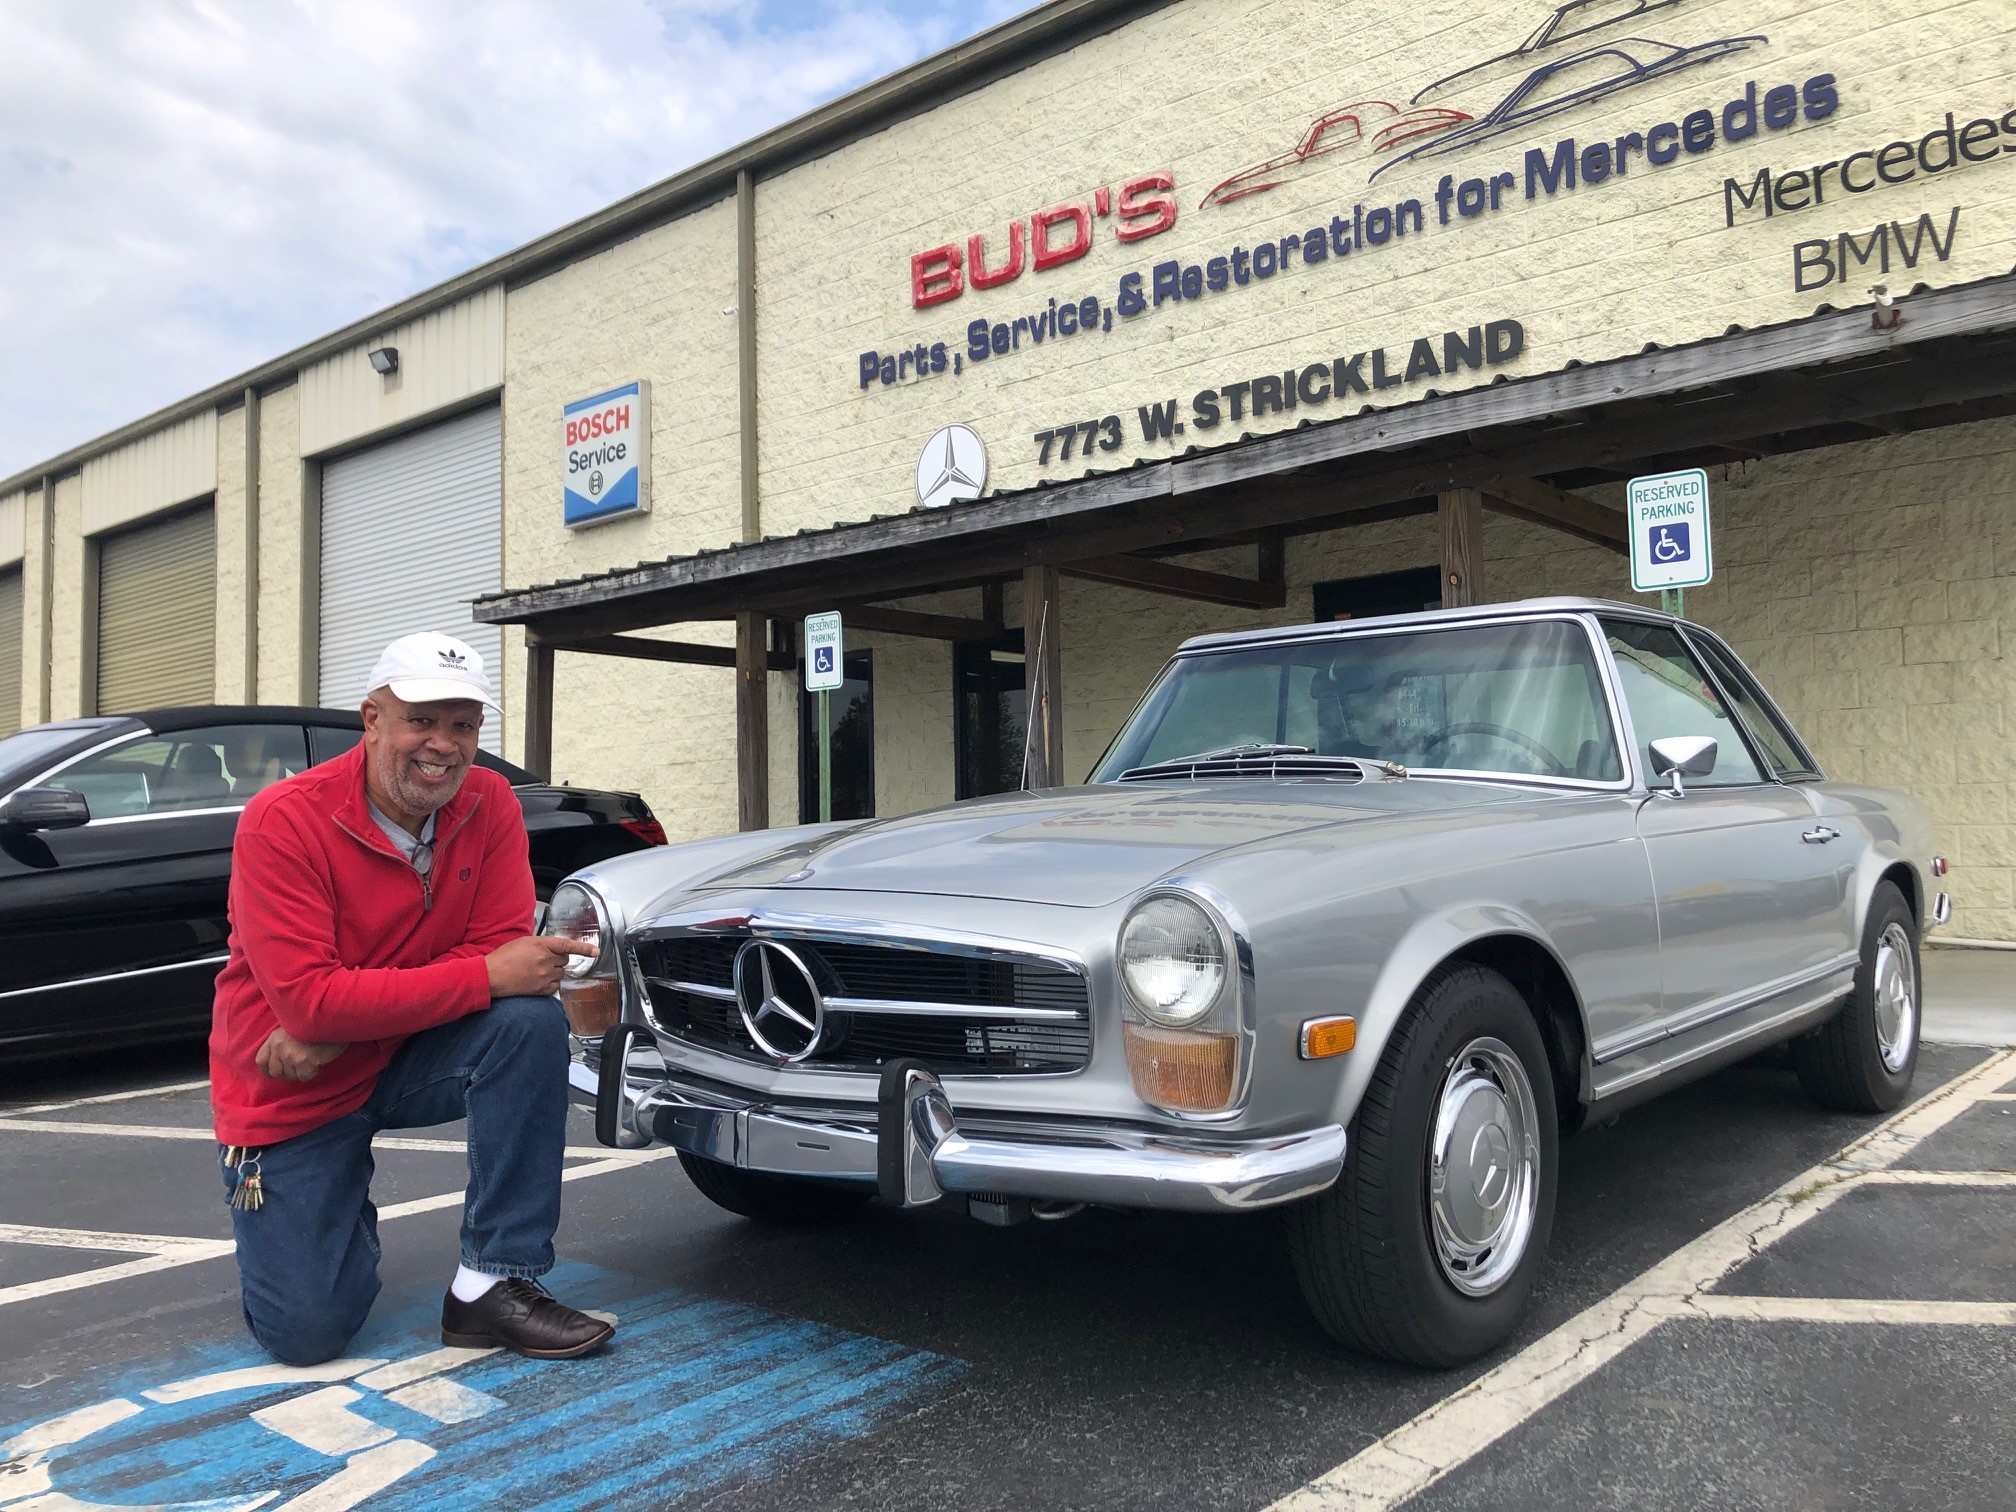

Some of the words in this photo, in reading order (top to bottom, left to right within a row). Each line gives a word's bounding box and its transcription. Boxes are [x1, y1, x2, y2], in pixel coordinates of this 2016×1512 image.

[967, 295, 1112, 362] Service,
[1117, 271, 1147, 317] &
[1152, 198, 1424, 307] Restoration
[1434, 168, 1514, 226] for
[1524, 72, 1839, 201] Mercedes
[910, 168, 1178, 310] BUD'S
[1792, 205, 1961, 293] BMW
[1033, 414, 1122, 466] 7773
[1137, 398, 1184, 442] W.
[1192, 318, 1525, 430] STRICKLAND
[566, 404, 630, 447] BOSCH
[568, 441, 627, 474] Service
[1634, 481, 1699, 504] RESERVED
[1641, 500, 1695, 521] PARKING
[808, 620, 838, 633] RESERVED
[811, 632, 836, 644] PARKING
[438, 662, 468, 672] adidas
